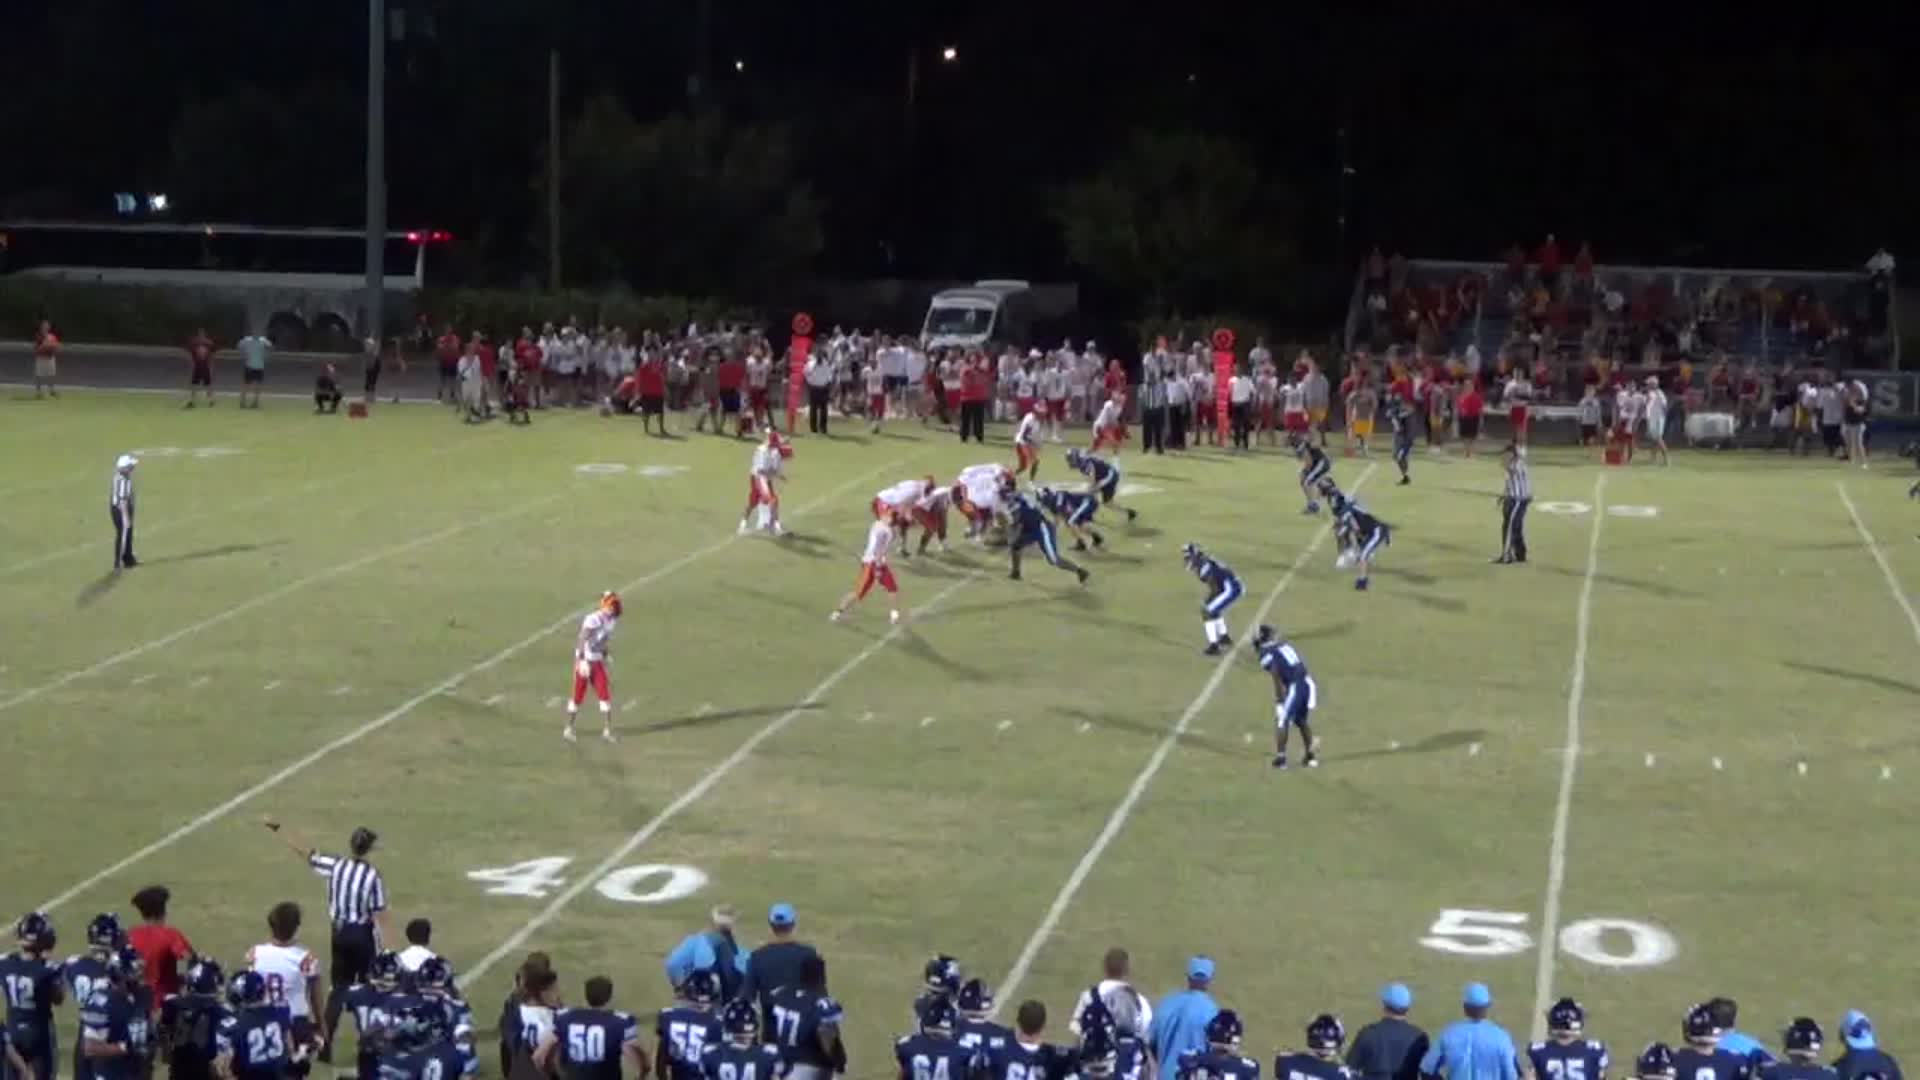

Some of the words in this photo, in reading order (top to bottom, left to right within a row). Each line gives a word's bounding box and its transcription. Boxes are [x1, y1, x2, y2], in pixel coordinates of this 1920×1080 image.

[467, 855, 709, 902] 40
[1418, 908, 1680, 966] 50
[6, 974, 36, 1008] 12
[247, 1021, 284, 1064] 23
[568, 1023, 606, 1062] 50
[669, 1021, 707, 1062] 55
[773, 1005, 800, 1047] 77
